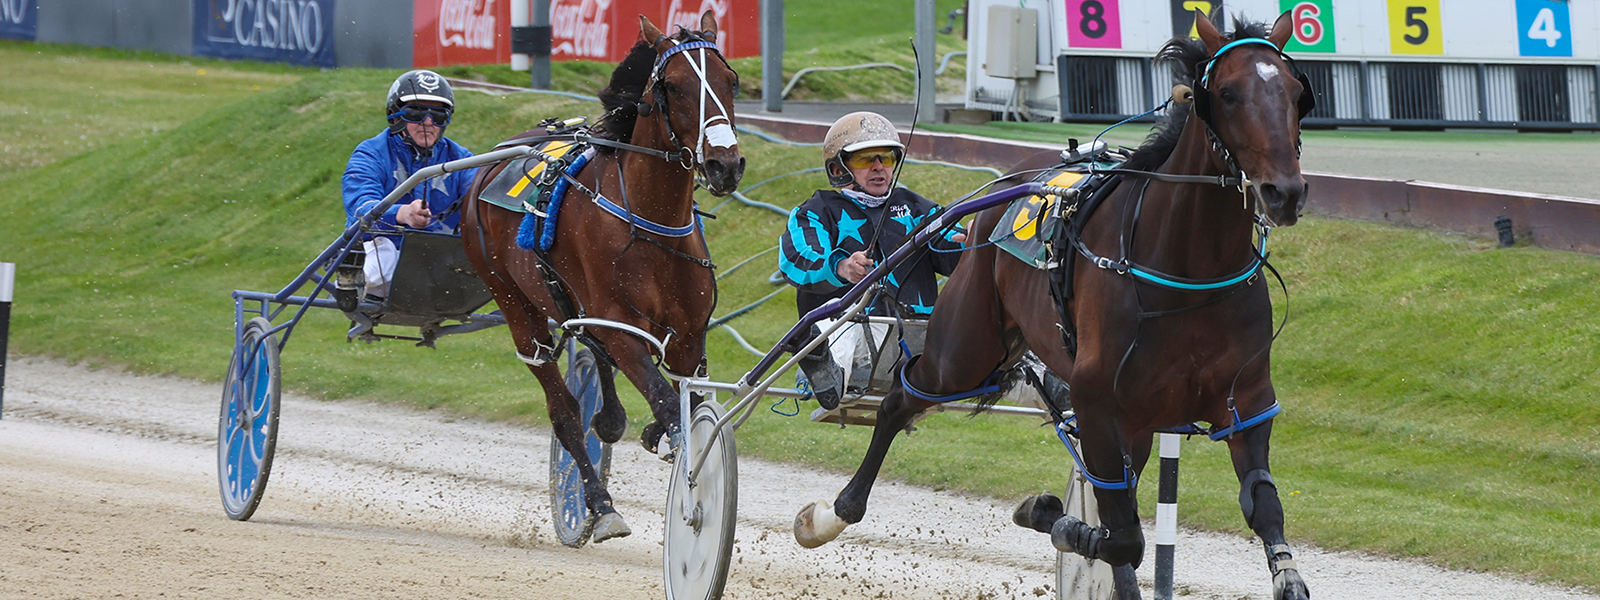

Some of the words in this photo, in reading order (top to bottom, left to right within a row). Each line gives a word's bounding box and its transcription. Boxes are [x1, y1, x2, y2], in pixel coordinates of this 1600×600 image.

[235, 0, 323, 54] CASINO
[1080, 0, 1107, 39] 8
[1183, 1, 1211, 40] 7
[1291, 1, 1324, 46] 6
[1403, 6, 1429, 45] 5
[1527, 8, 1562, 48] 4
